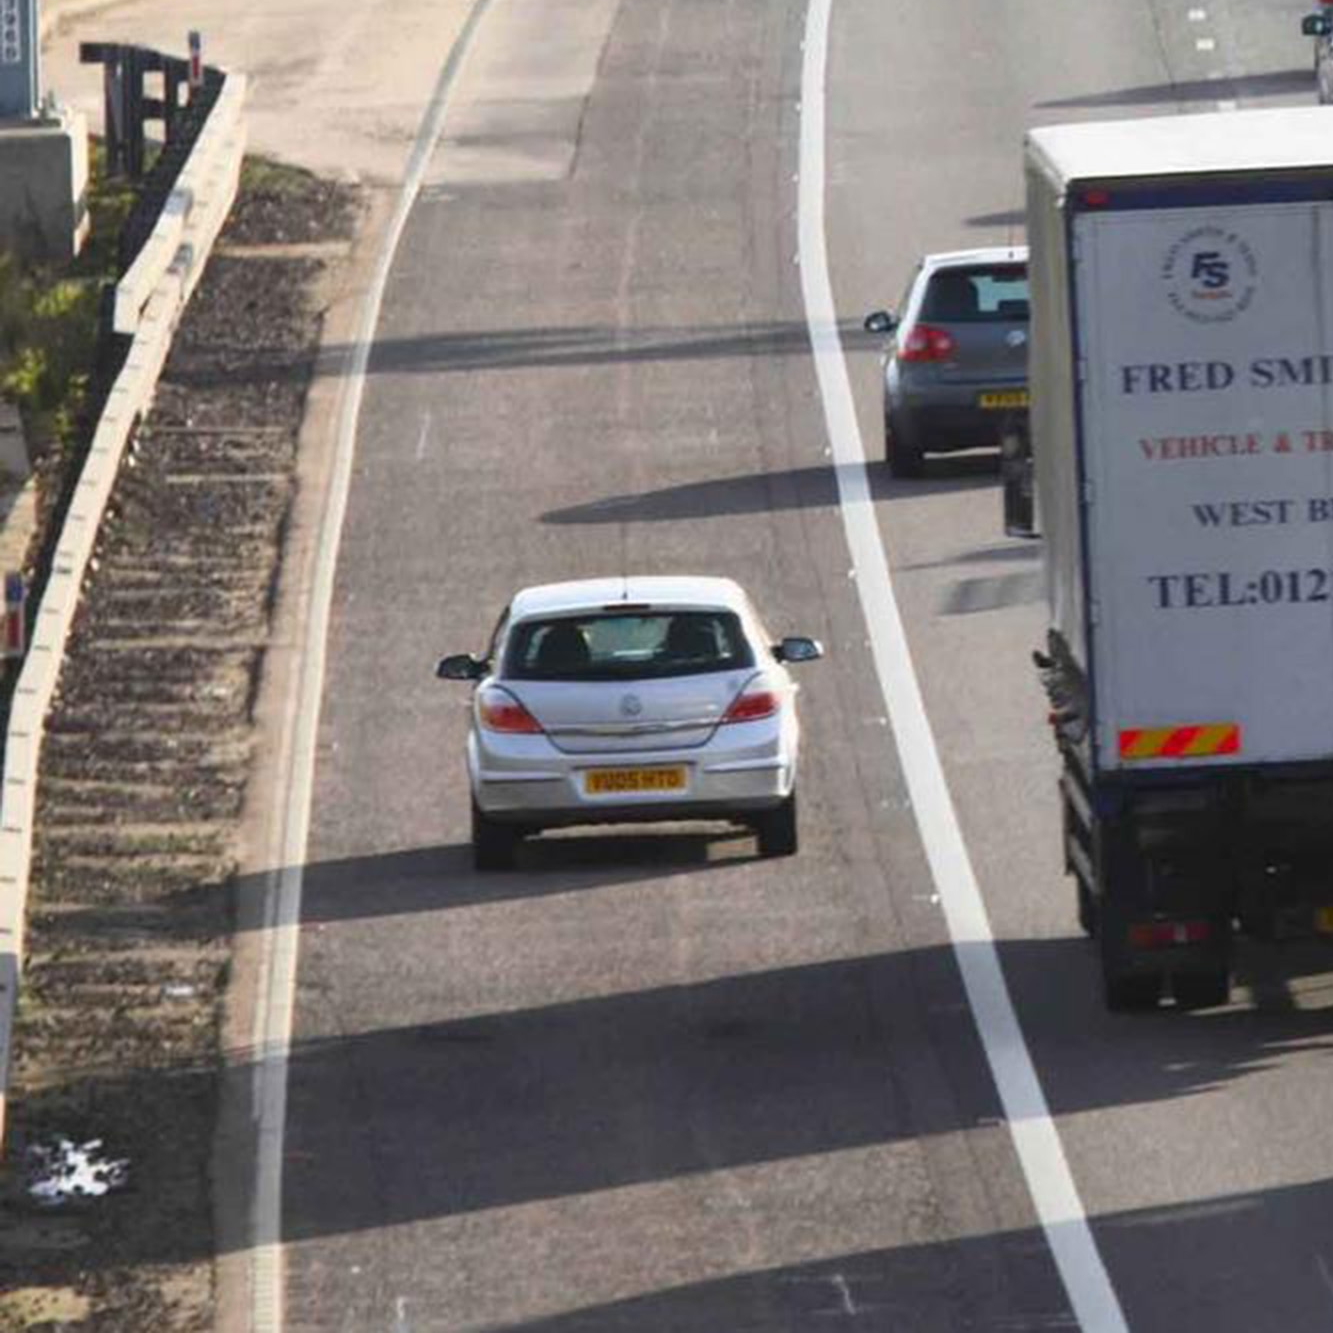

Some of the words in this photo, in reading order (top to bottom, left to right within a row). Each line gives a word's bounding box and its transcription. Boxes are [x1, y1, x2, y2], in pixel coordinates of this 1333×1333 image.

[1190, 251, 1231, 289] FS
[1121, 360, 1234, 395] FRED
[1138, 433, 1261, 463] VEHICLE
[1273, 434, 1293, 455] &
[1191, 498, 1295, 529] WEST
